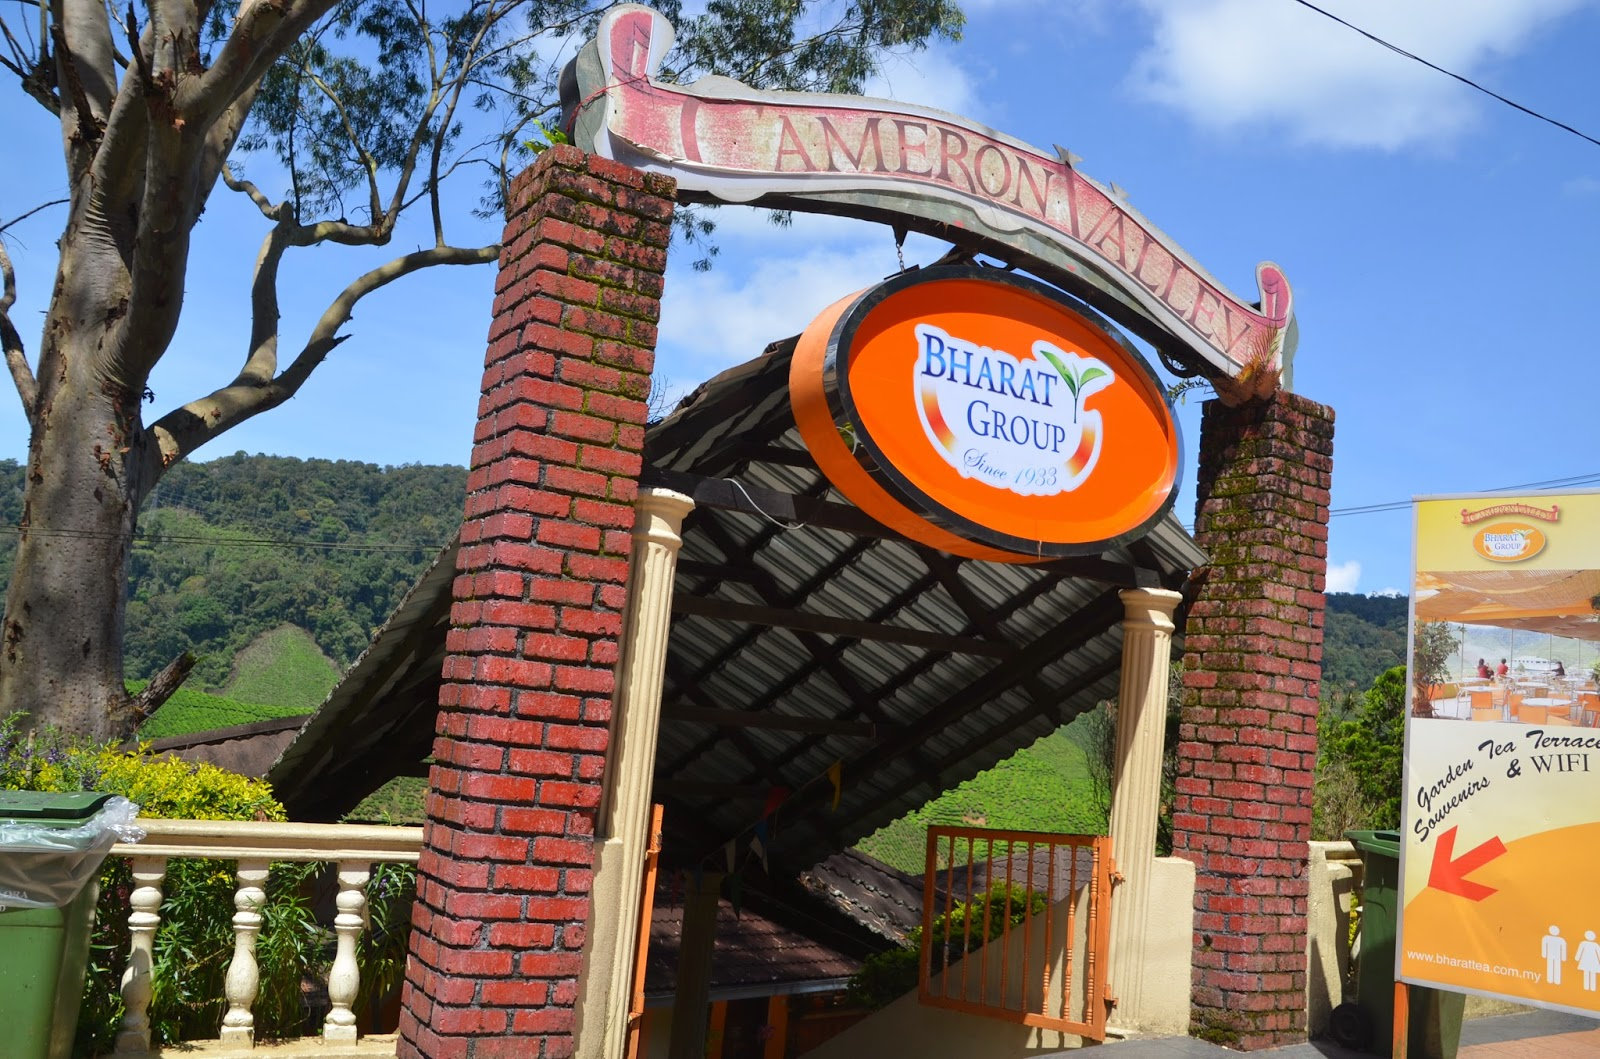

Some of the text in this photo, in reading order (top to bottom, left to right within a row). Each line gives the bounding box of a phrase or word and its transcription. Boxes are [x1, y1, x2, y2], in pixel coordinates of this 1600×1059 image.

[1063, 165, 1251, 354] VALLEY
[921, 332, 1058, 407] BHARAT
[967, 400, 1066, 453] GROUP
[963, 448, 1057, 487] Since 1933
[1484, 533, 1518, 542] BHARAT
[1494, 542, 1521, 550] GROUP
[1417, 729, 1600, 812] Garden Tea Terrace
[1414, 753, 1590, 842] Souvenirs & WIFI
[1407, 950, 1541, 983] www.bharattea.com.my
